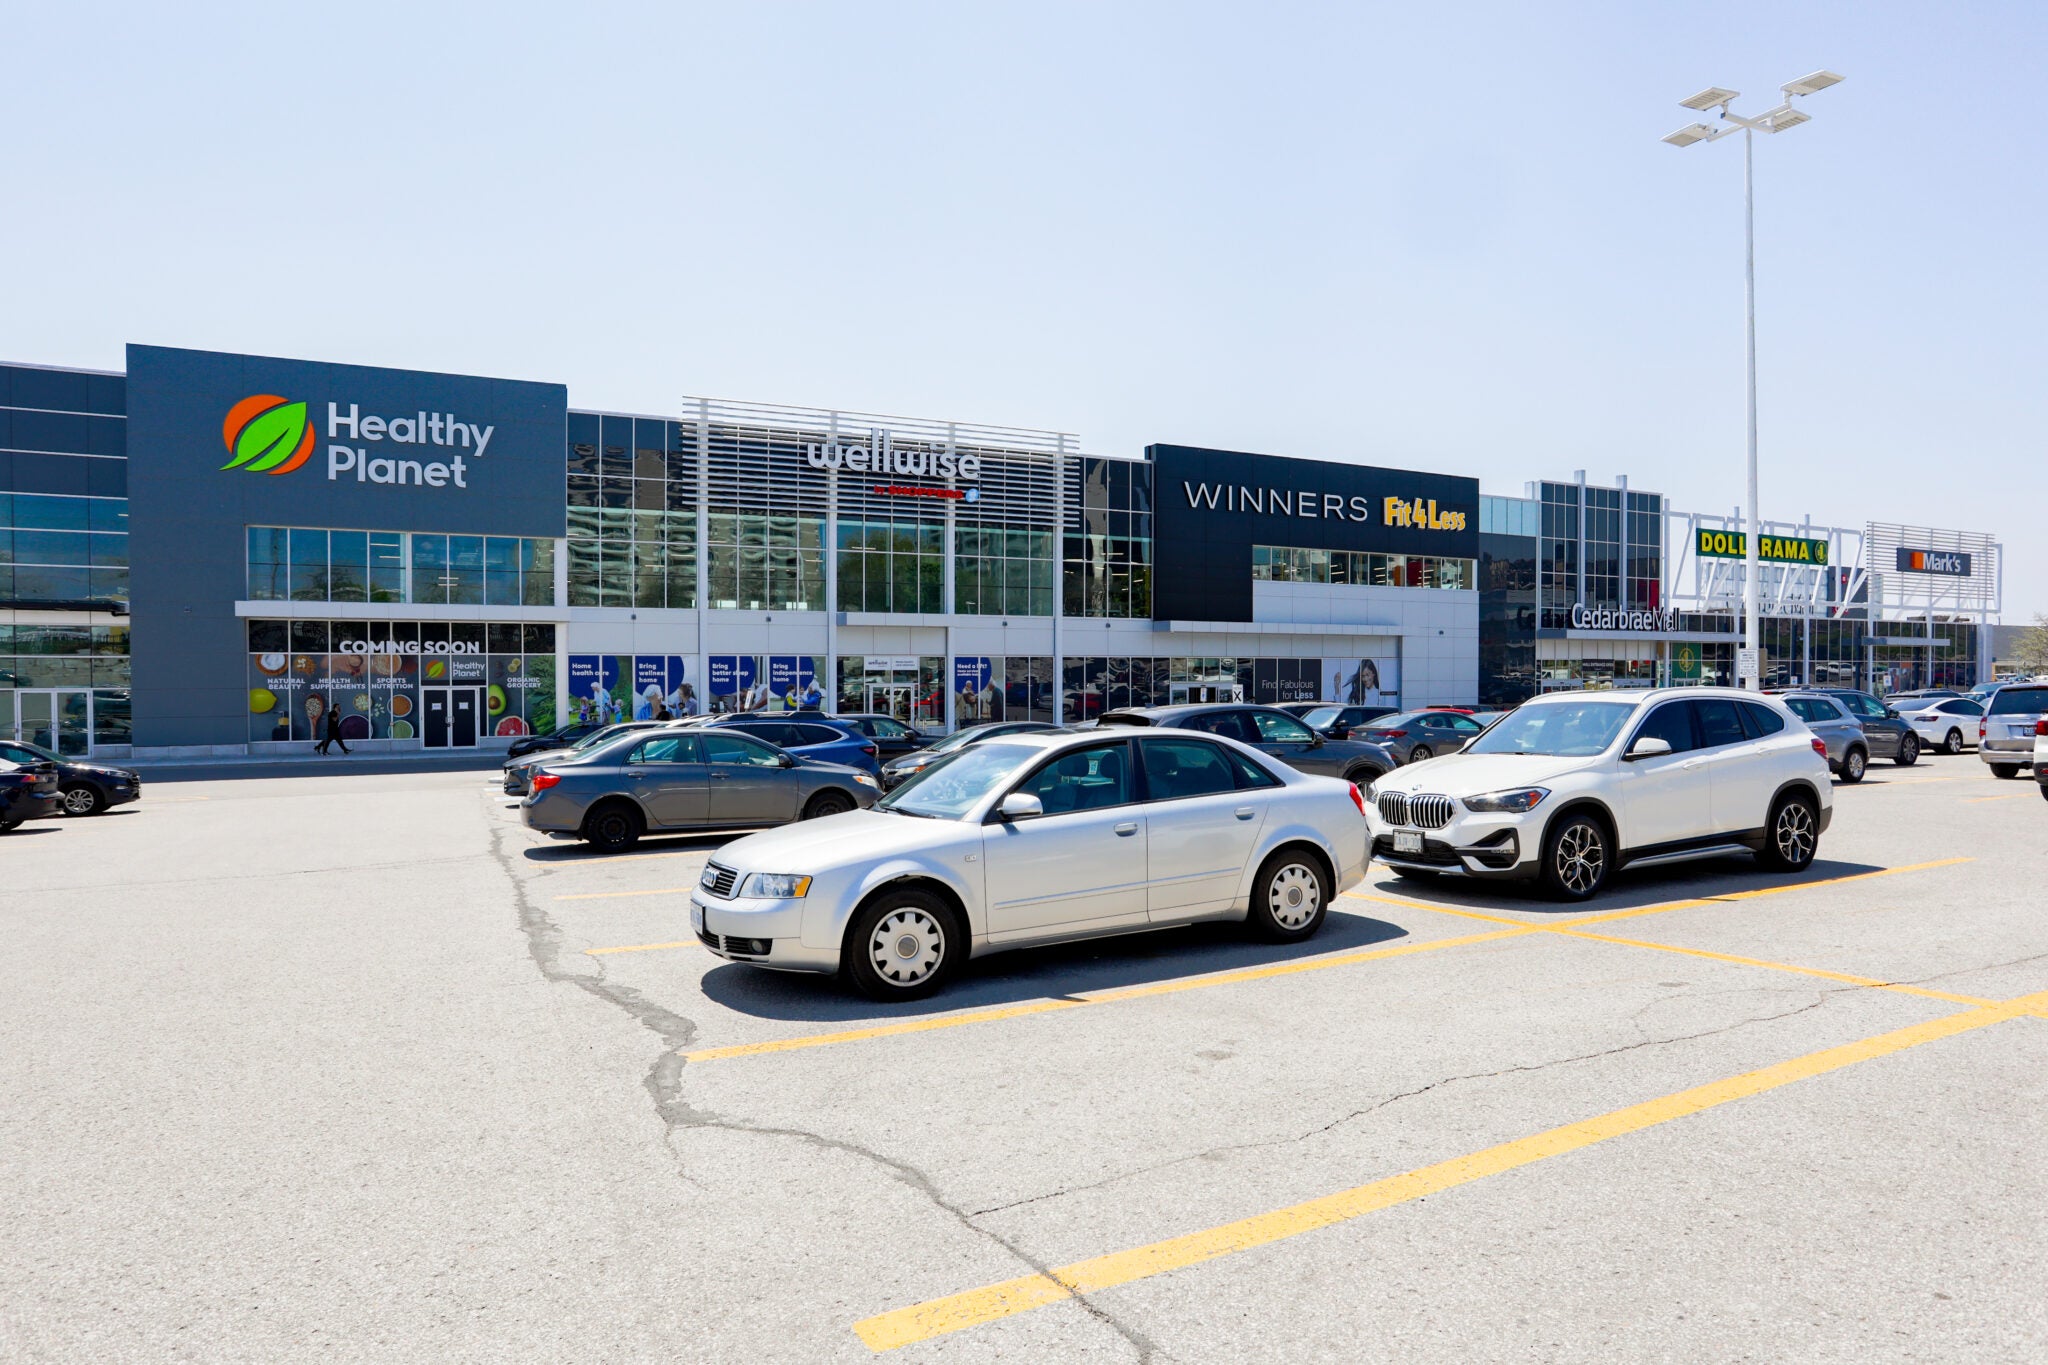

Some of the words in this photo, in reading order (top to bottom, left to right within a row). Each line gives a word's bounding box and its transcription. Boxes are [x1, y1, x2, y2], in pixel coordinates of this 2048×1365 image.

[328, 402, 495, 457] Healthy
[807, 427, 980, 480] wellwise
[328, 445, 467, 488] Planet
[888, 485, 964, 500] SHOPPERS
[1184, 481, 1368, 522] WINNERS
[1383, 496, 1466, 531] Fit4Less
[1701, 532, 1810, 560] DOLLRAMA
[1923, 552, 1961, 573] Mark's
[339, 640, 419, 654] COMING
[423, 640, 480, 654] SOON
[452, 661, 485, 671] Healthy
[452, 669, 480, 677] Planet
[1261, 679, 1279, 689] Find
[1280, 679, 1314, 689] Fabulous
[1282, 690, 1293, 699] for
[1294, 690, 1314, 699] Less
